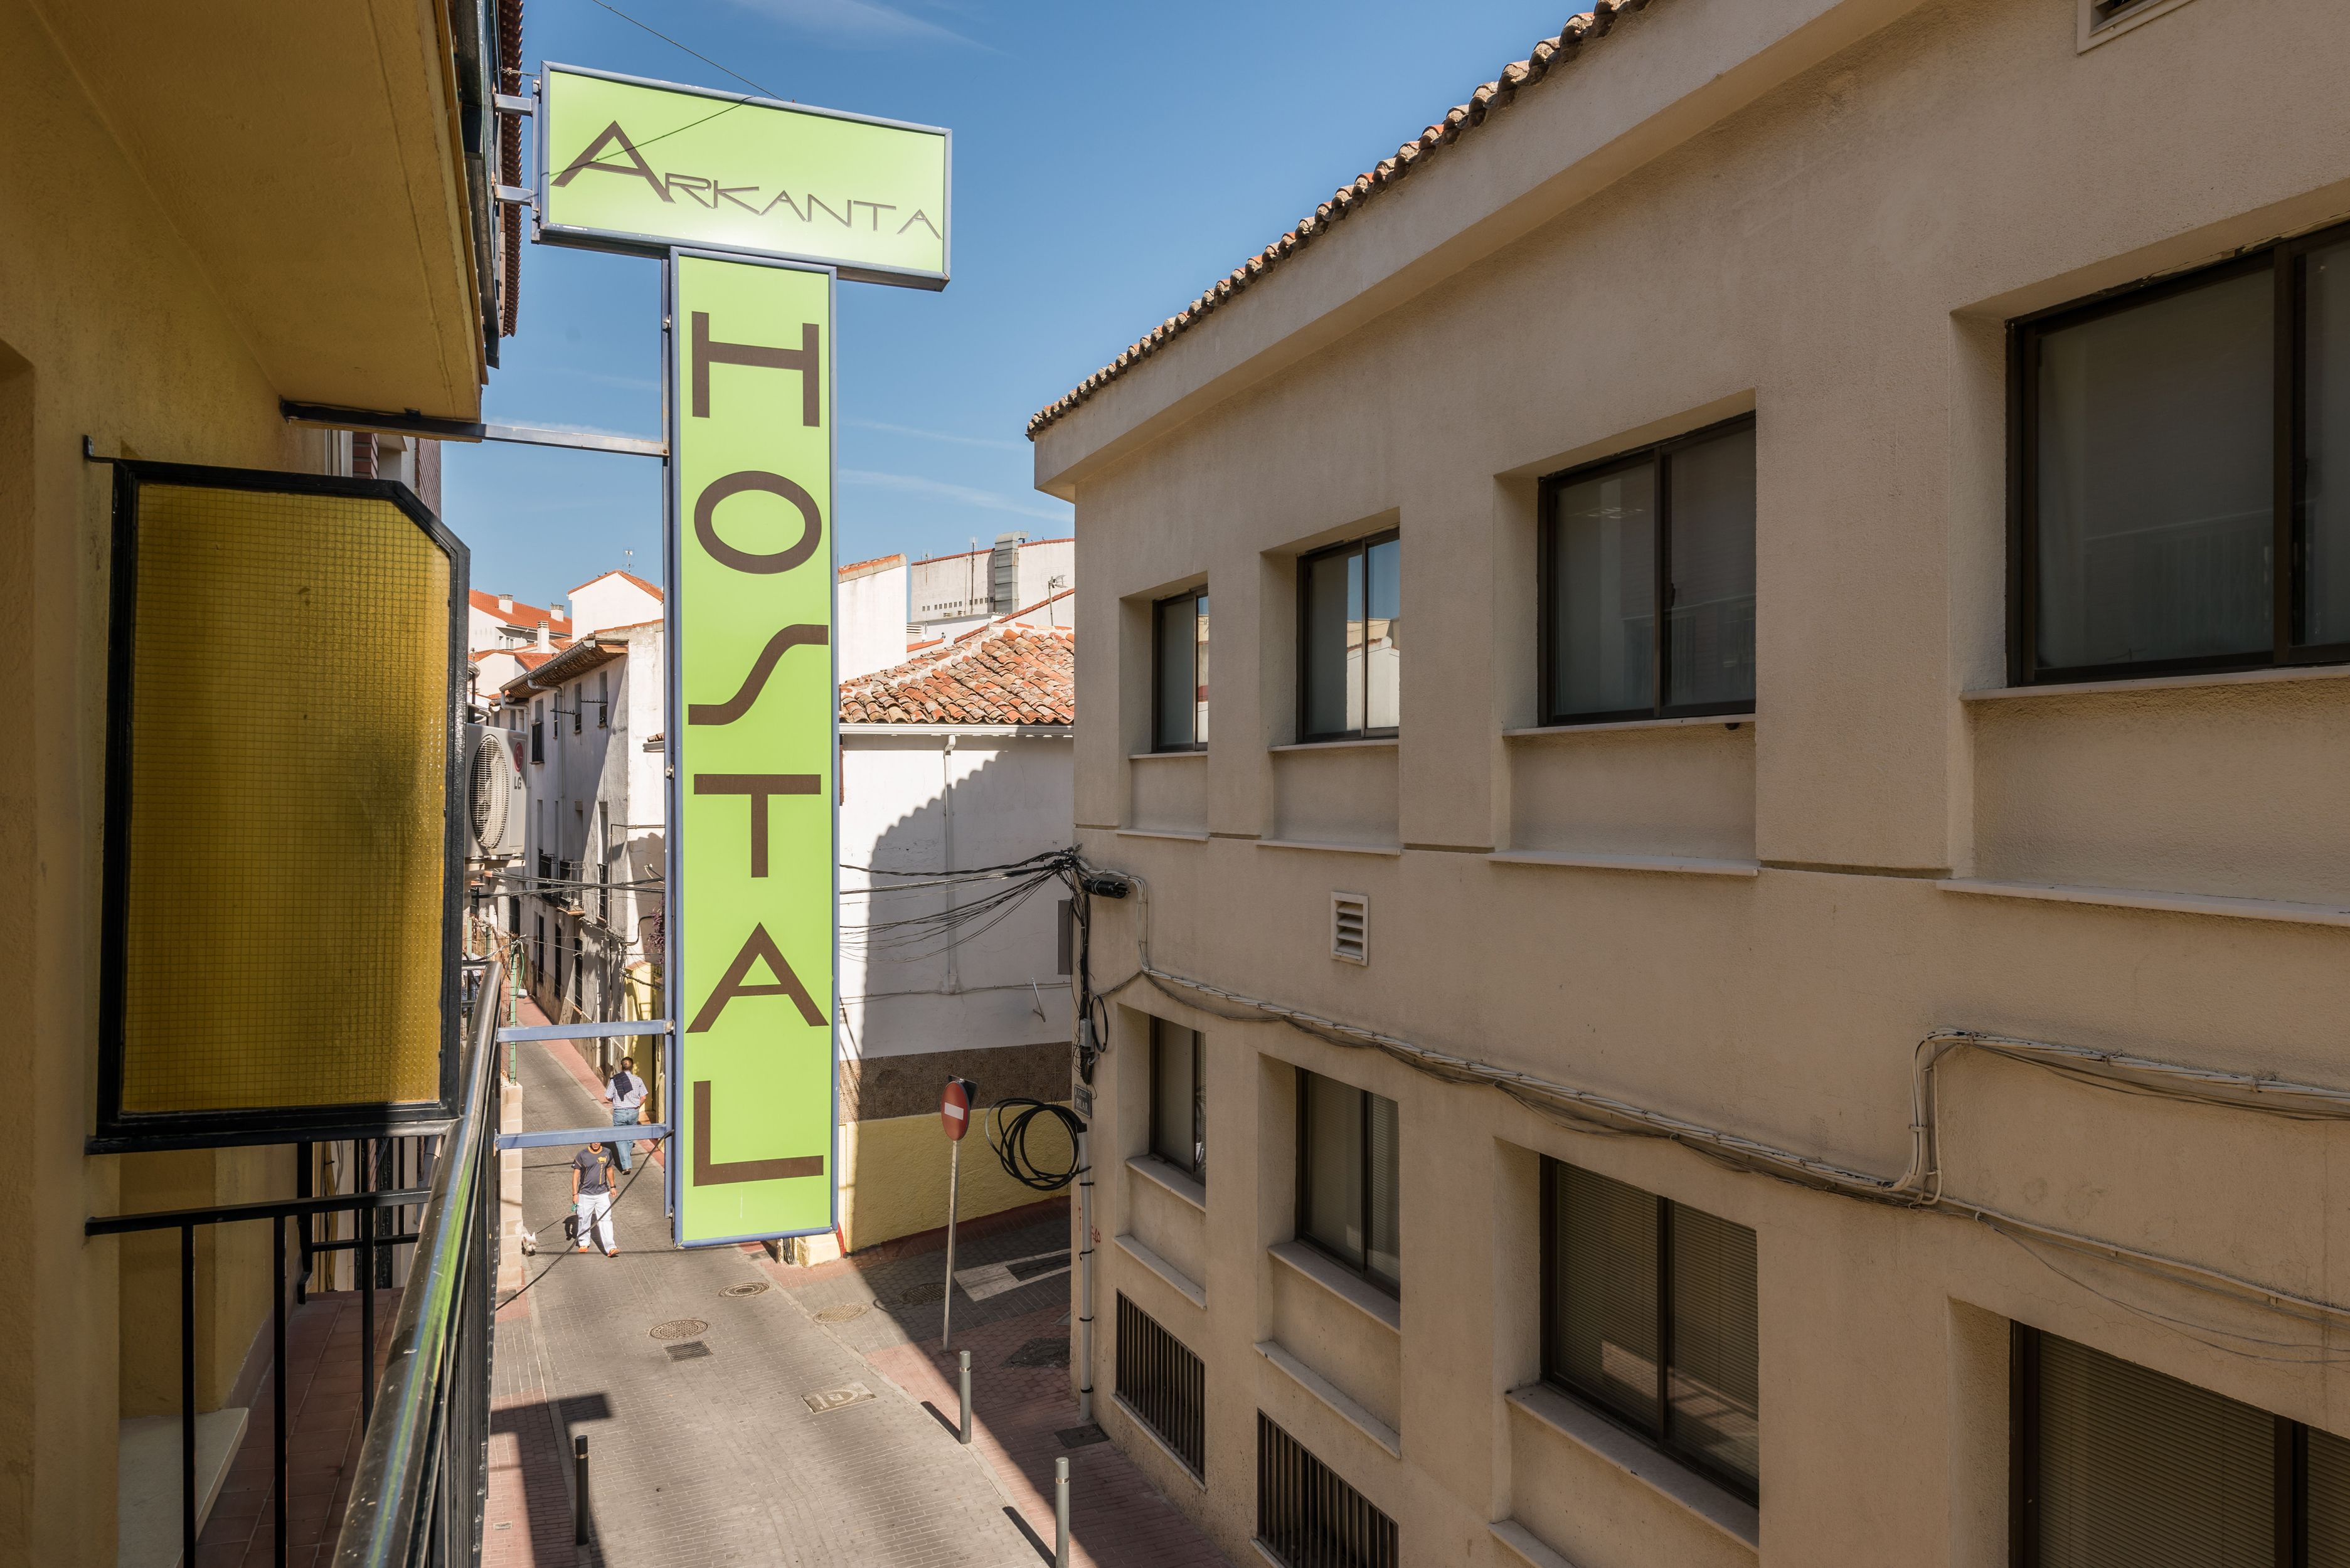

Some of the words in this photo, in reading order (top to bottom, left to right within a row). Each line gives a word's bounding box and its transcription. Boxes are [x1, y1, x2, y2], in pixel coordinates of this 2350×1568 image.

[550, 120, 943, 240] ARKANTA
[685, 310, 830, 1187] HOSTAL
[514, 776, 522, 790] LG
[1076, 1098, 1088, 1112] PILAR
